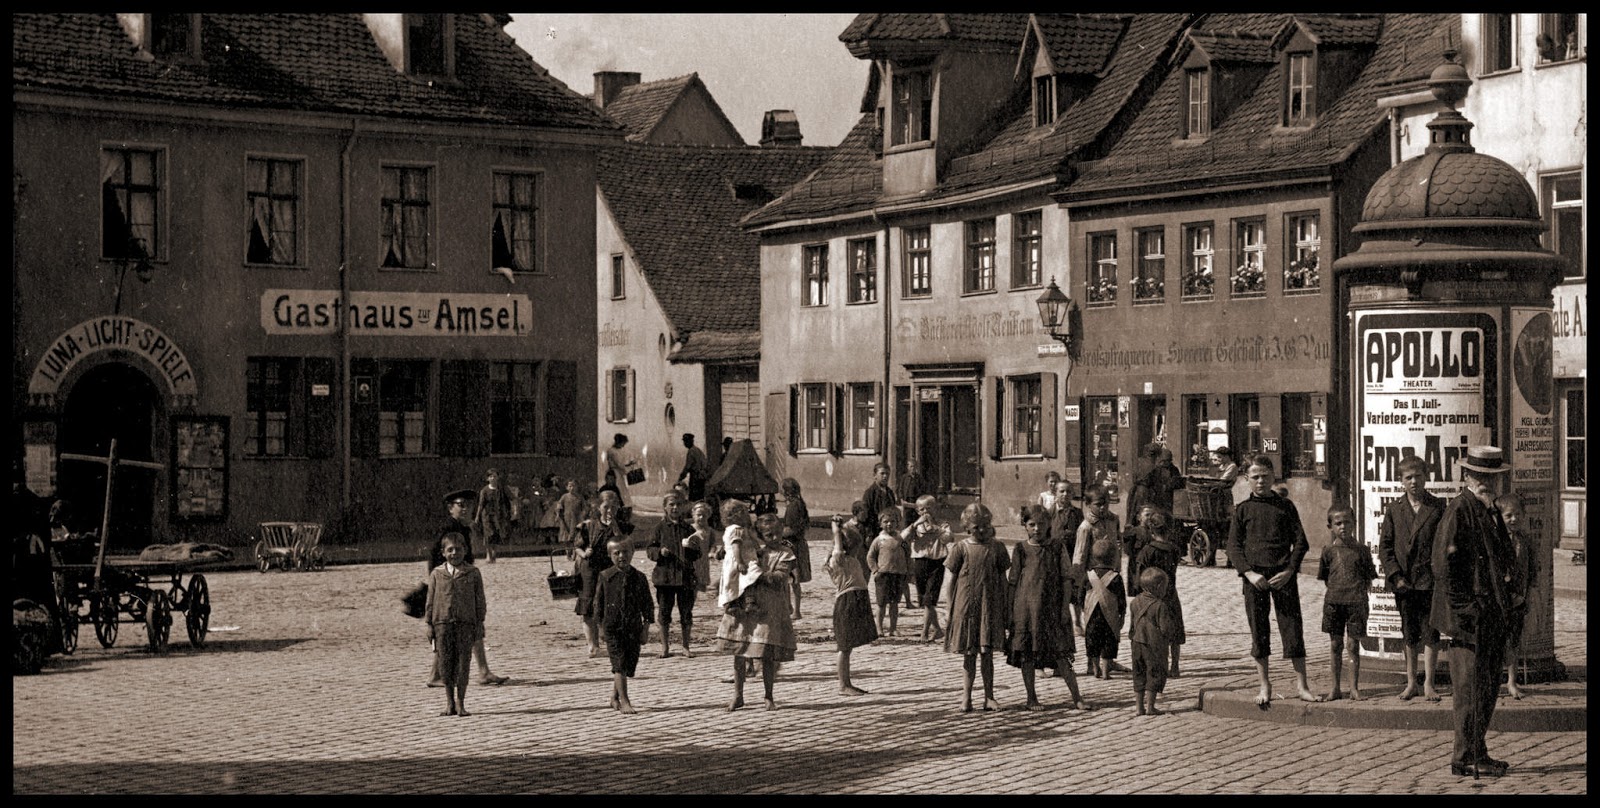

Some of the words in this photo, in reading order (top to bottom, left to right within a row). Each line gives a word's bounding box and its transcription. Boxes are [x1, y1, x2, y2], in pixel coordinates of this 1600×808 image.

[434, 298, 525, 335] Amsel.
[1366, 331, 1480, 383] APOLLO
[1393, 399, 1409, 409] Das
[1421, 399, 1441, 409] Juli-
[1366, 411, 1480, 426] Varietee-Programm
[1263, 437, 1277, 453] Pilo
